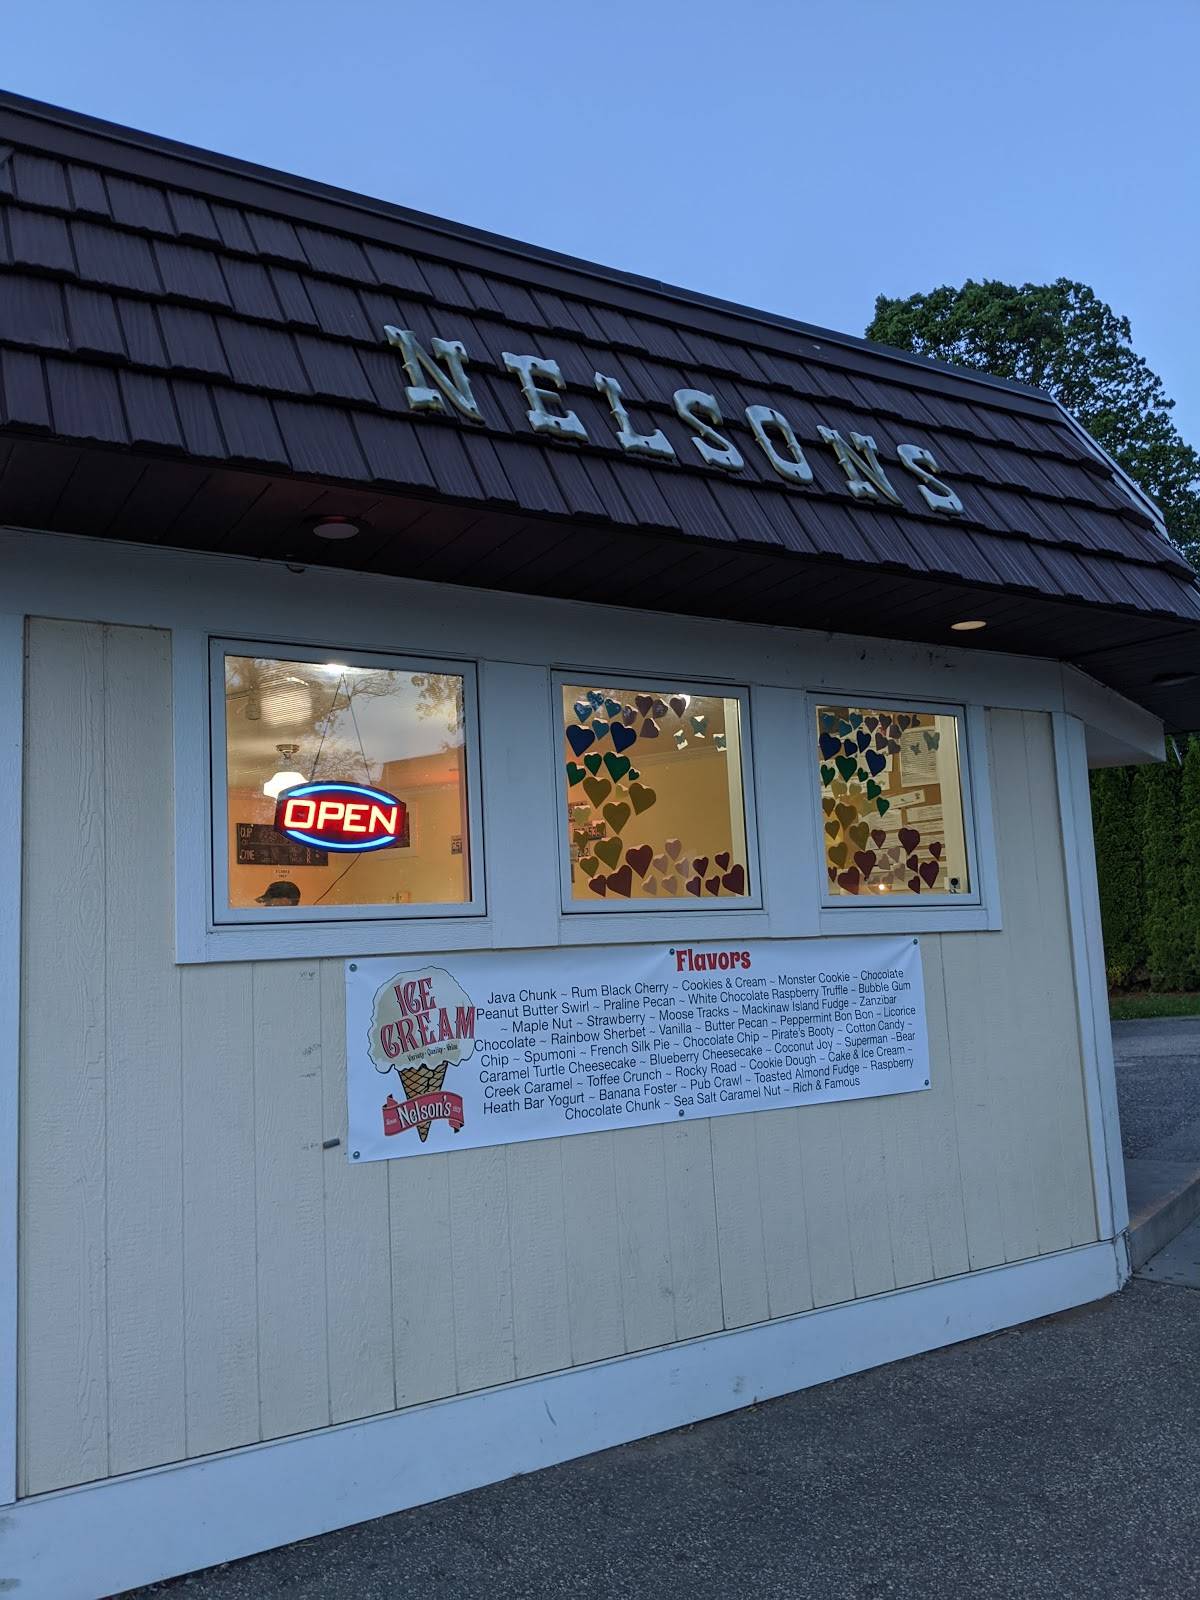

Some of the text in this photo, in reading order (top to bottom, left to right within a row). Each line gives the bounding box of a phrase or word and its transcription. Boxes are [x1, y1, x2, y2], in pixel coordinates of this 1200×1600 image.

[382, 323, 965, 516] NELSONS
[284, 799, 398, 834] OPEN
[676, 948, 751, 971] Flavors
[393, 977, 437, 1017] ICE
[476, 981, 911, 1020] Peanut Butter Swirl Praline Pecan White Chocolate Raspberry Truffle Bubble Gum
[487, 969, 904, 1004] Java Chunk Rum Black Cherry Cookies & Cream Monster Cookie Chocolate
[381, 1006, 475, 1059] CREAM
[474, 1006, 916, 1052] Chocolate Rainbow Sherbet Vanilla Butter Pecan Peppermint Bon Bon Licorice
[512, 995, 896, 1034] Maple Nut Strawberry Moose Tracks Mackinaw Island Fudge Zanzibar
[480, 1067, 530, 1083] Caramel
[533, 1064, 565, 1077] Turtle
[568, 1058, 637, 1074] Cheesecake
[649, 1052, 699, 1066] Blueberry
[702, 1046, 763, 1061] Cheesecake
[774, 1041, 814, 1054] Coconut
[816, 1040, 833, 1051] Joy
[844, 1034, 888, 1048] Superman
[481, 1019, 905, 1068] Chip Spumoni French Silk Pie Chocolate Chip Pirate's Booty Cotton Candy
[483, 1058, 914, 1114] Heath Bar Yogurt Banana Foster Pub Crawl Toasted Almond Fudge Raspberry
[484, 1045, 905, 1099] Creek Caramel Toffee Crunch Rocky Road Cookie Dough Cake & Ice Cream
[397, 1095, 451, 1128] Nelson's
[565, 1077, 860, 1120] Chocolate Chunk Sea Salt Caramel Nut Rich & Famous
